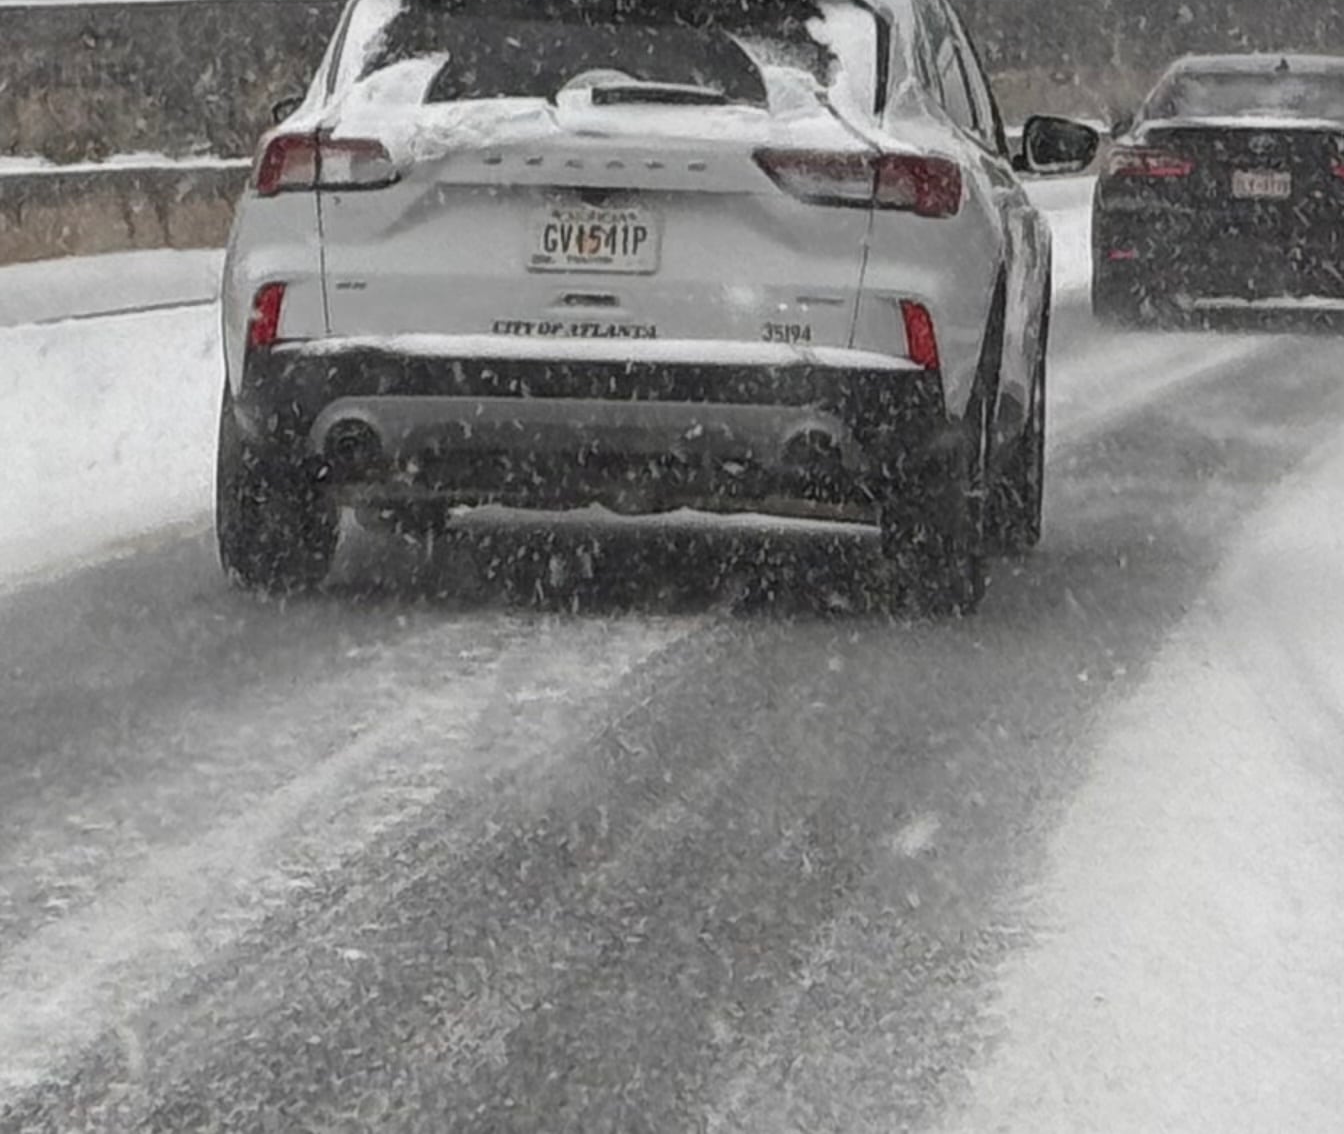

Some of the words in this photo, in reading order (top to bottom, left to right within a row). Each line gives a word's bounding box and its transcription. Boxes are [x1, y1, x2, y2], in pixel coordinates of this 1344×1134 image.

[492, 320, 536, 336] CITY
[537, 321, 564, 336] OF
[566, 322, 657, 339] ATLANTA
[761, 322, 811, 343] 35194
